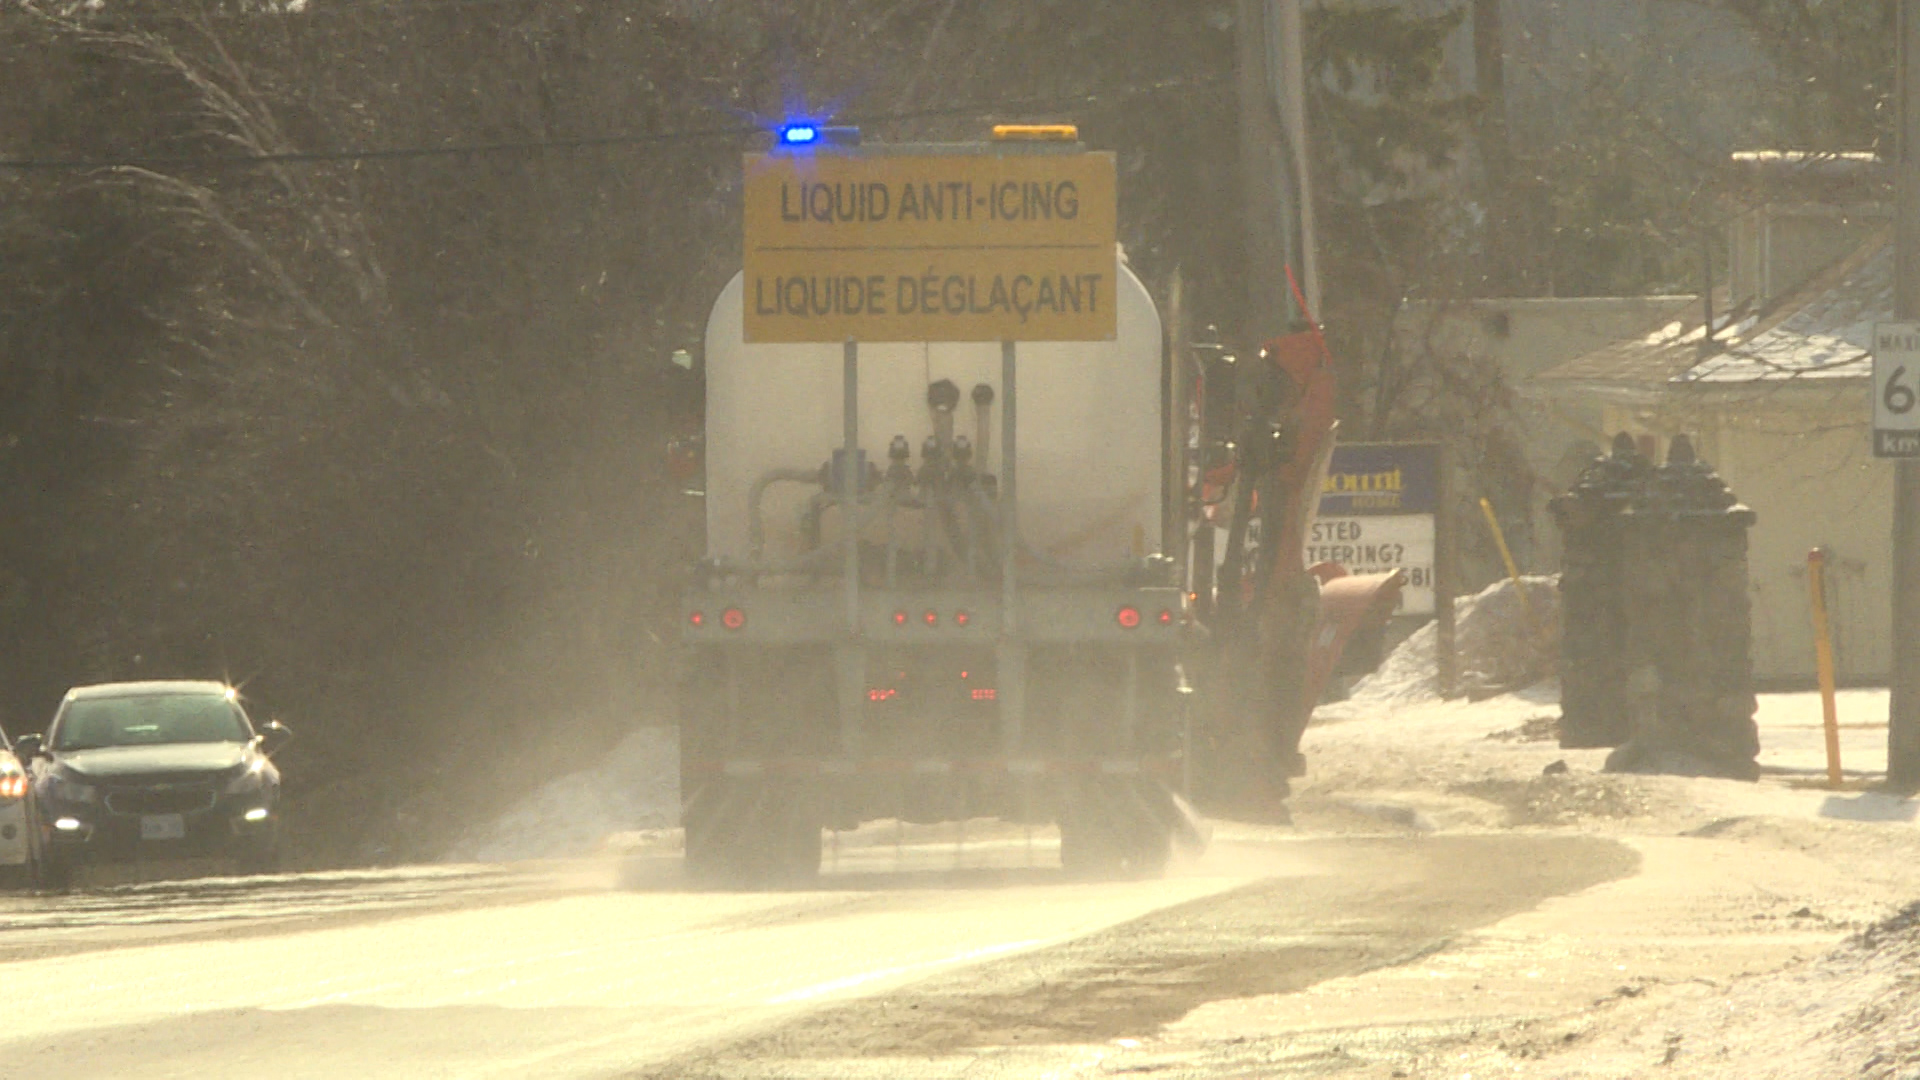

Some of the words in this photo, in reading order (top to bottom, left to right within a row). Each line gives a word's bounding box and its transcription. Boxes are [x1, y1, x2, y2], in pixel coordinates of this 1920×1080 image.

[781, 181, 890, 224] LIQUID
[897, 179, 1079, 221] ANTI-ICING
[756, 274, 887, 319] LIQUIDE
[896, 265, 1103, 324] DÉGLAÇANT
[1884, 365, 1920, 415] 6
